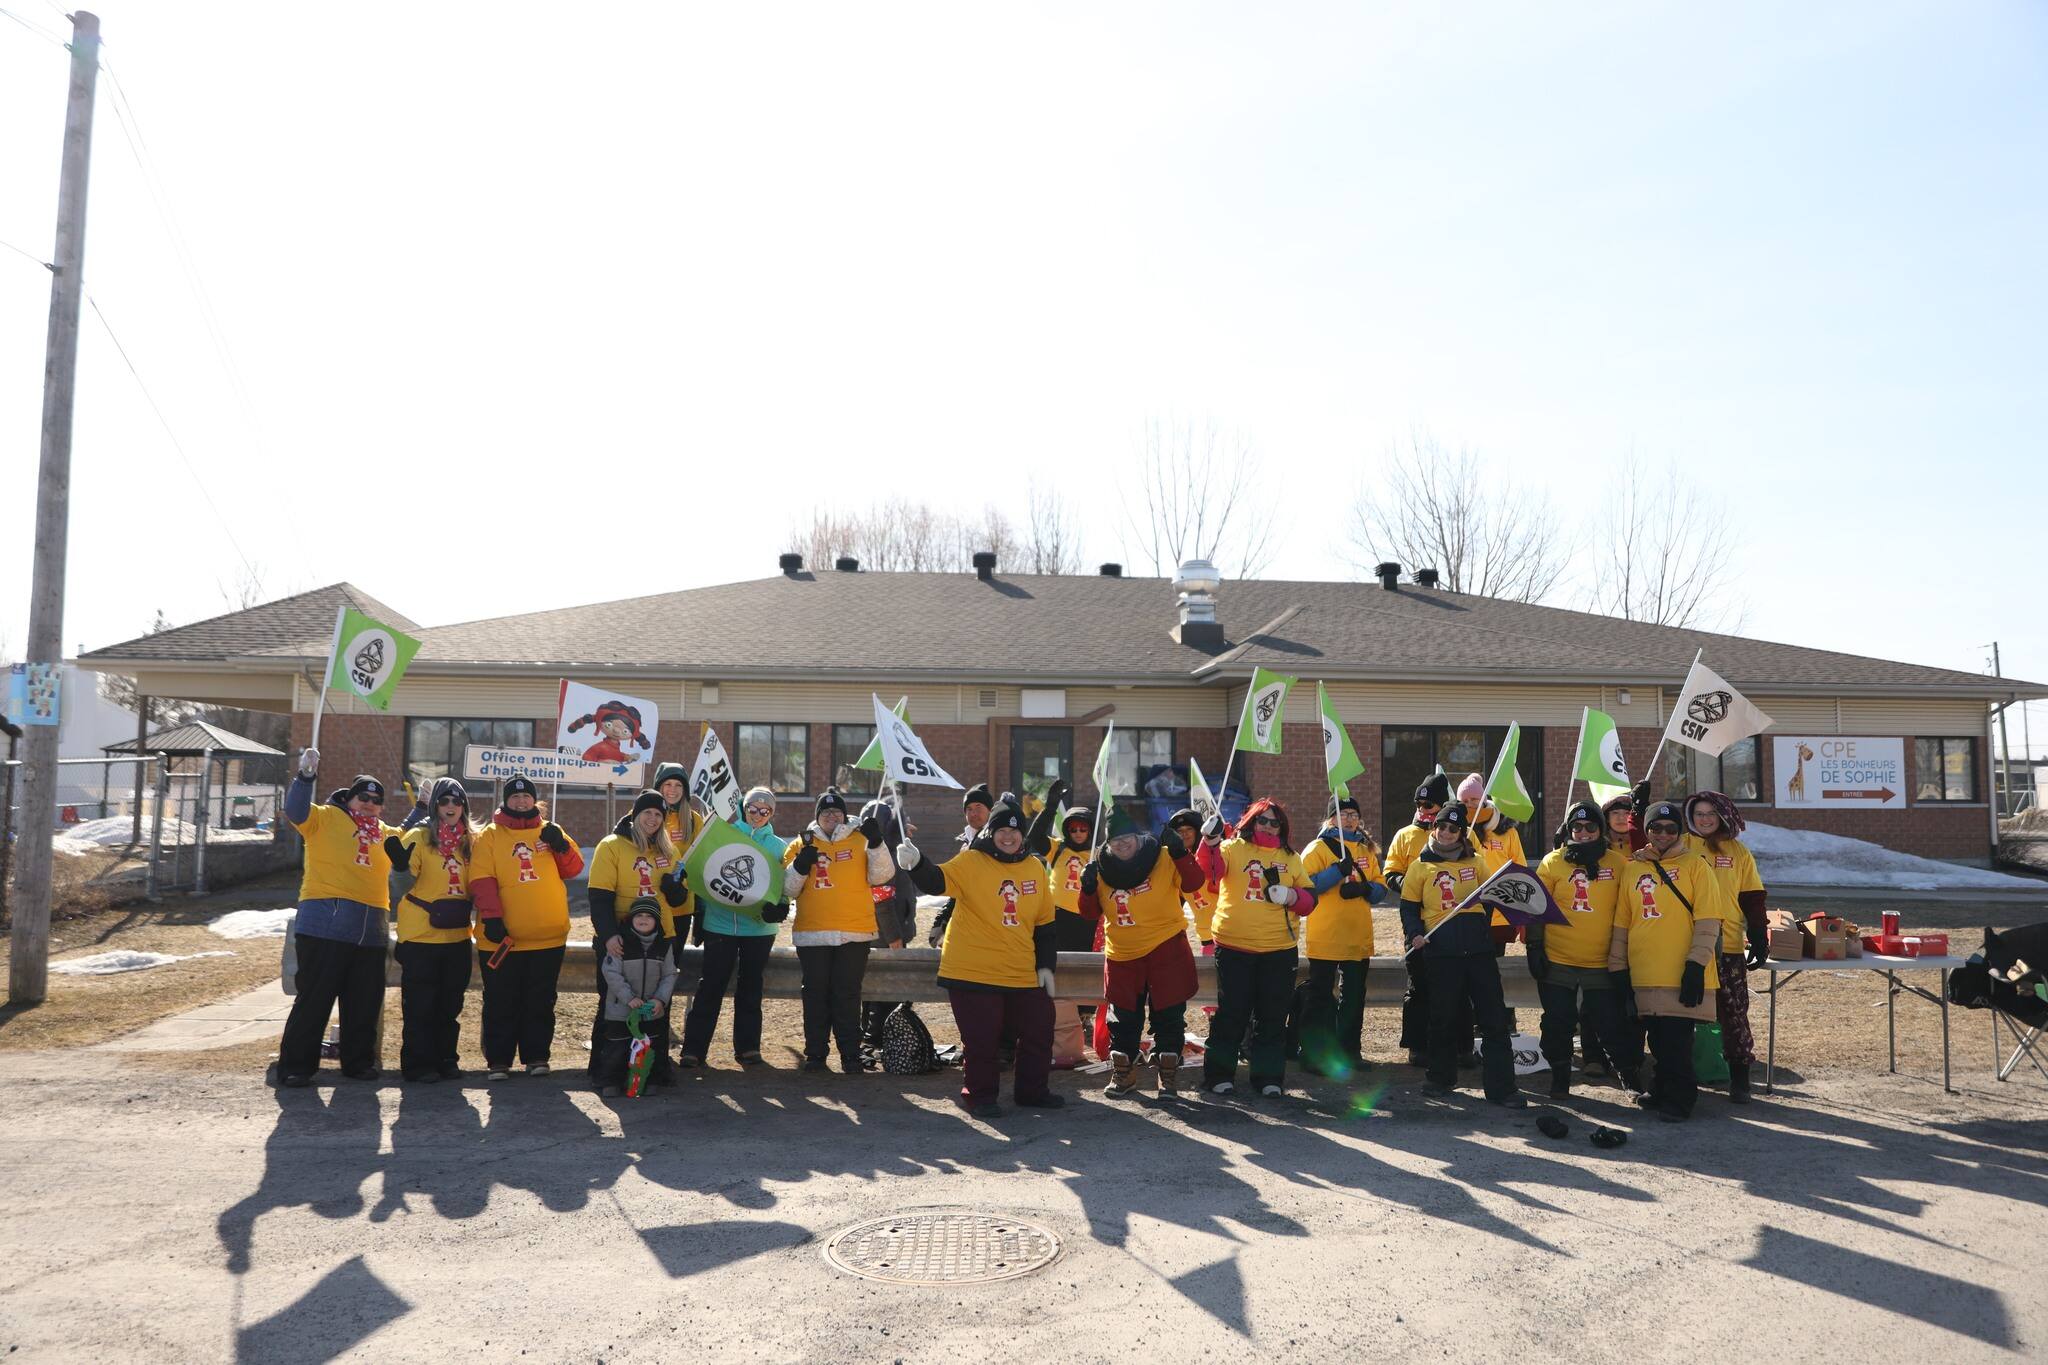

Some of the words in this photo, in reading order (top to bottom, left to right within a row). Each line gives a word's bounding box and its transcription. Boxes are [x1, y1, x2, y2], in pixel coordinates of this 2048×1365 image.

[352, 669, 375, 690] CSN
[1681, 719, 1709, 742] CSN
[481, 751, 525, 764] Office
[1820, 741, 1857, 759] CPE
[1820, 760, 1838, 769] LES
[1841, 760, 1896, 769] BONHEURS
[1821, 771, 1840, 783] DE
[1845, 771, 1896, 783] SOPHIE
[710, 878, 744, 904] CSN
